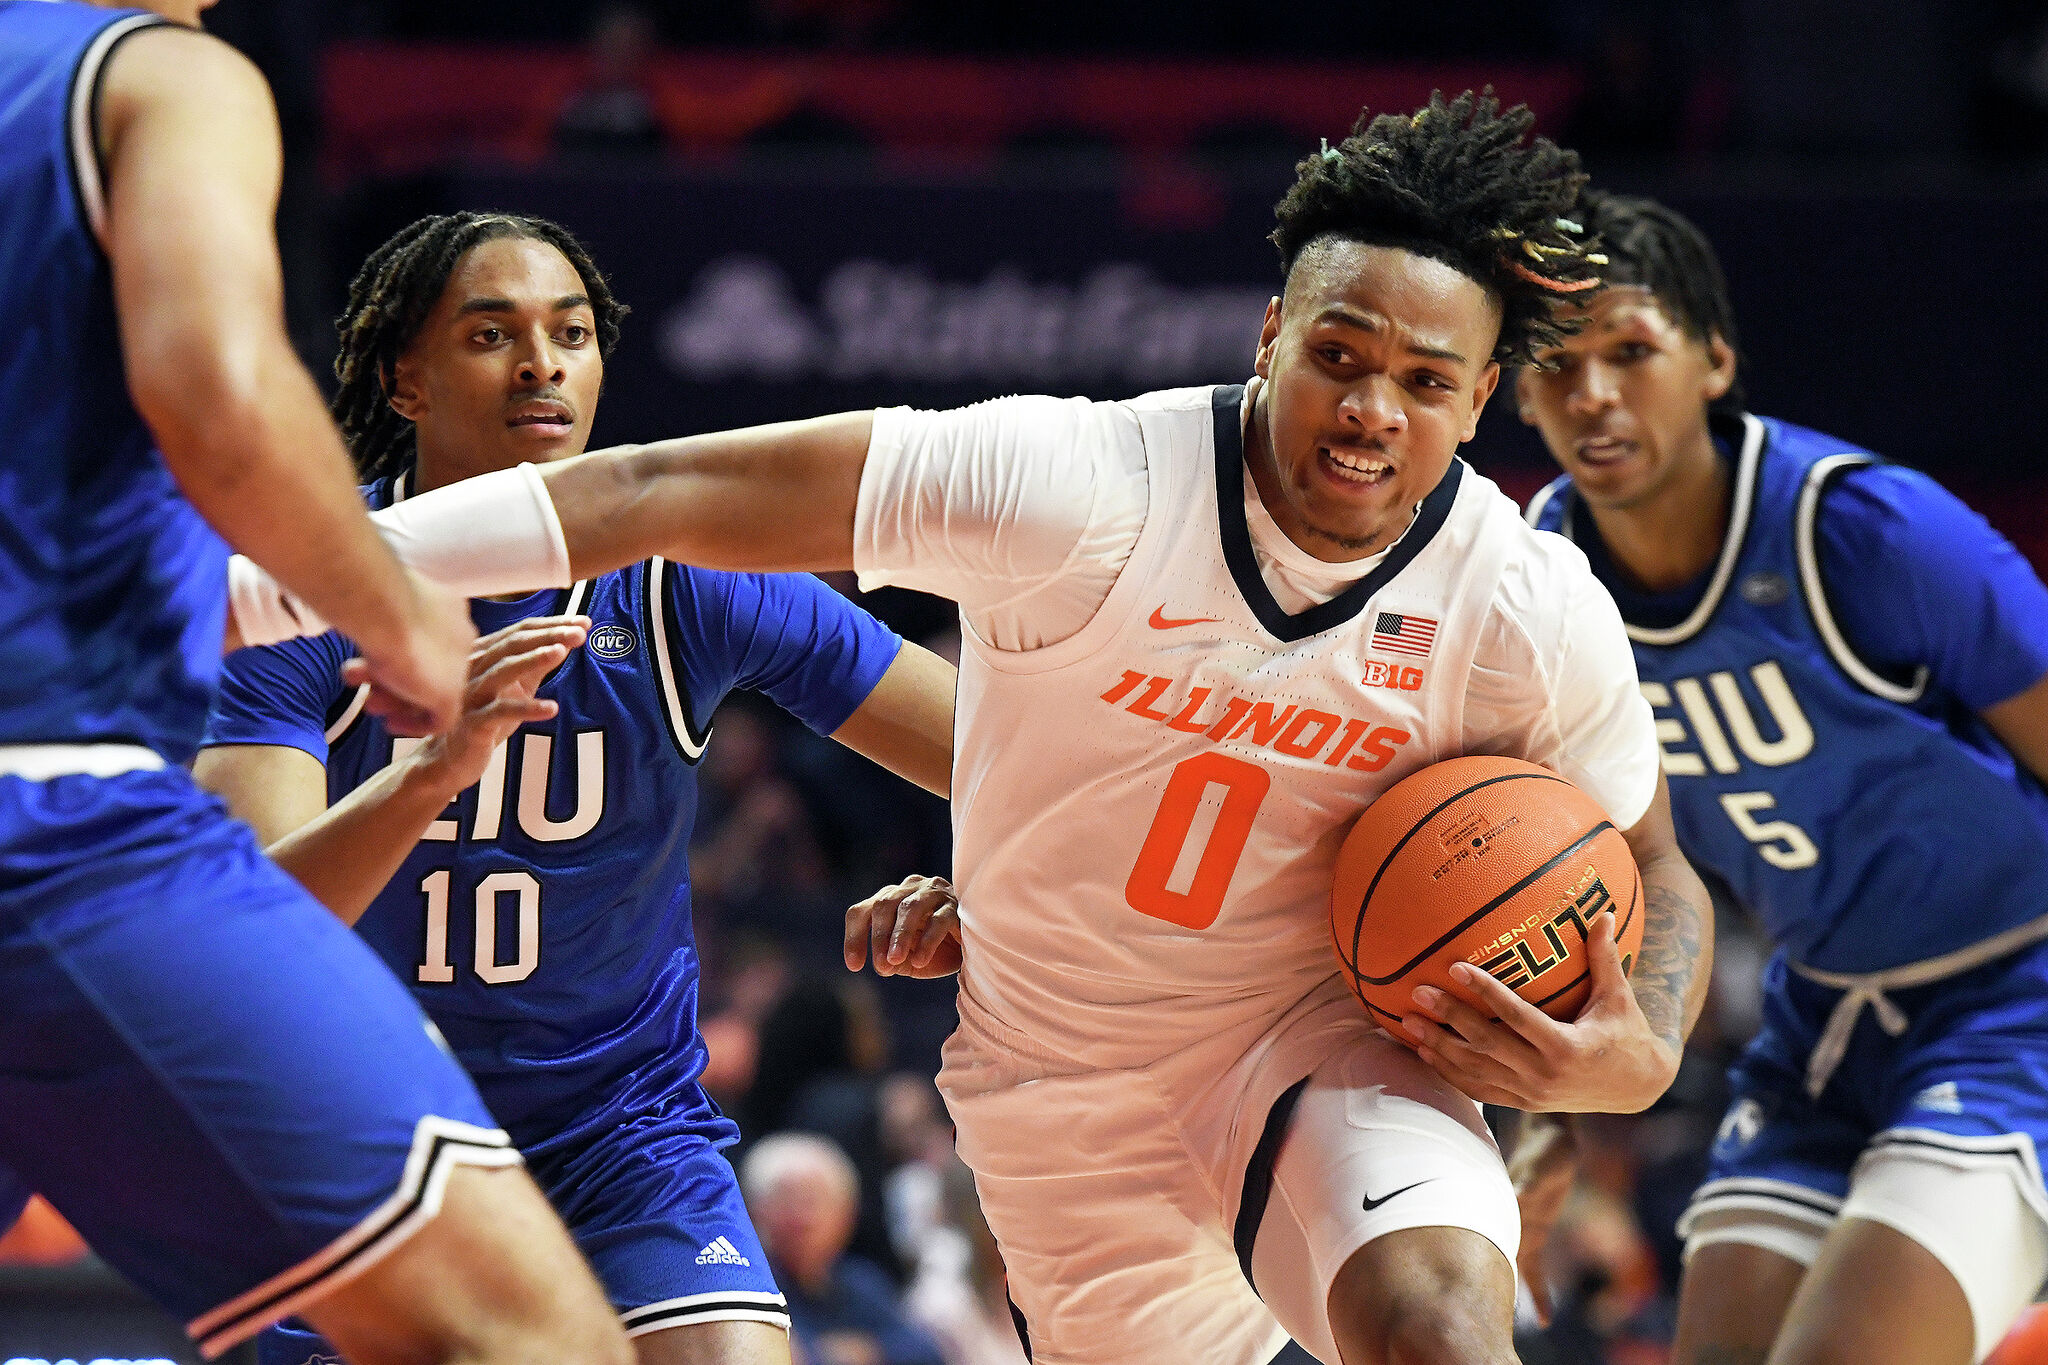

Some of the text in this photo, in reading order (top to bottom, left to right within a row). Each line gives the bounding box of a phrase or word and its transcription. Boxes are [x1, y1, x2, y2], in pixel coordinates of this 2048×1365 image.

[597, 635, 625, 649] OVC
[1100, 669, 1412, 773] ILLINOIS
[1124, 751, 1271, 931] 0
[1720, 791, 1820, 871] 5
[418, 870, 541, 985] 10
[695, 1251, 751, 1267] adidas
